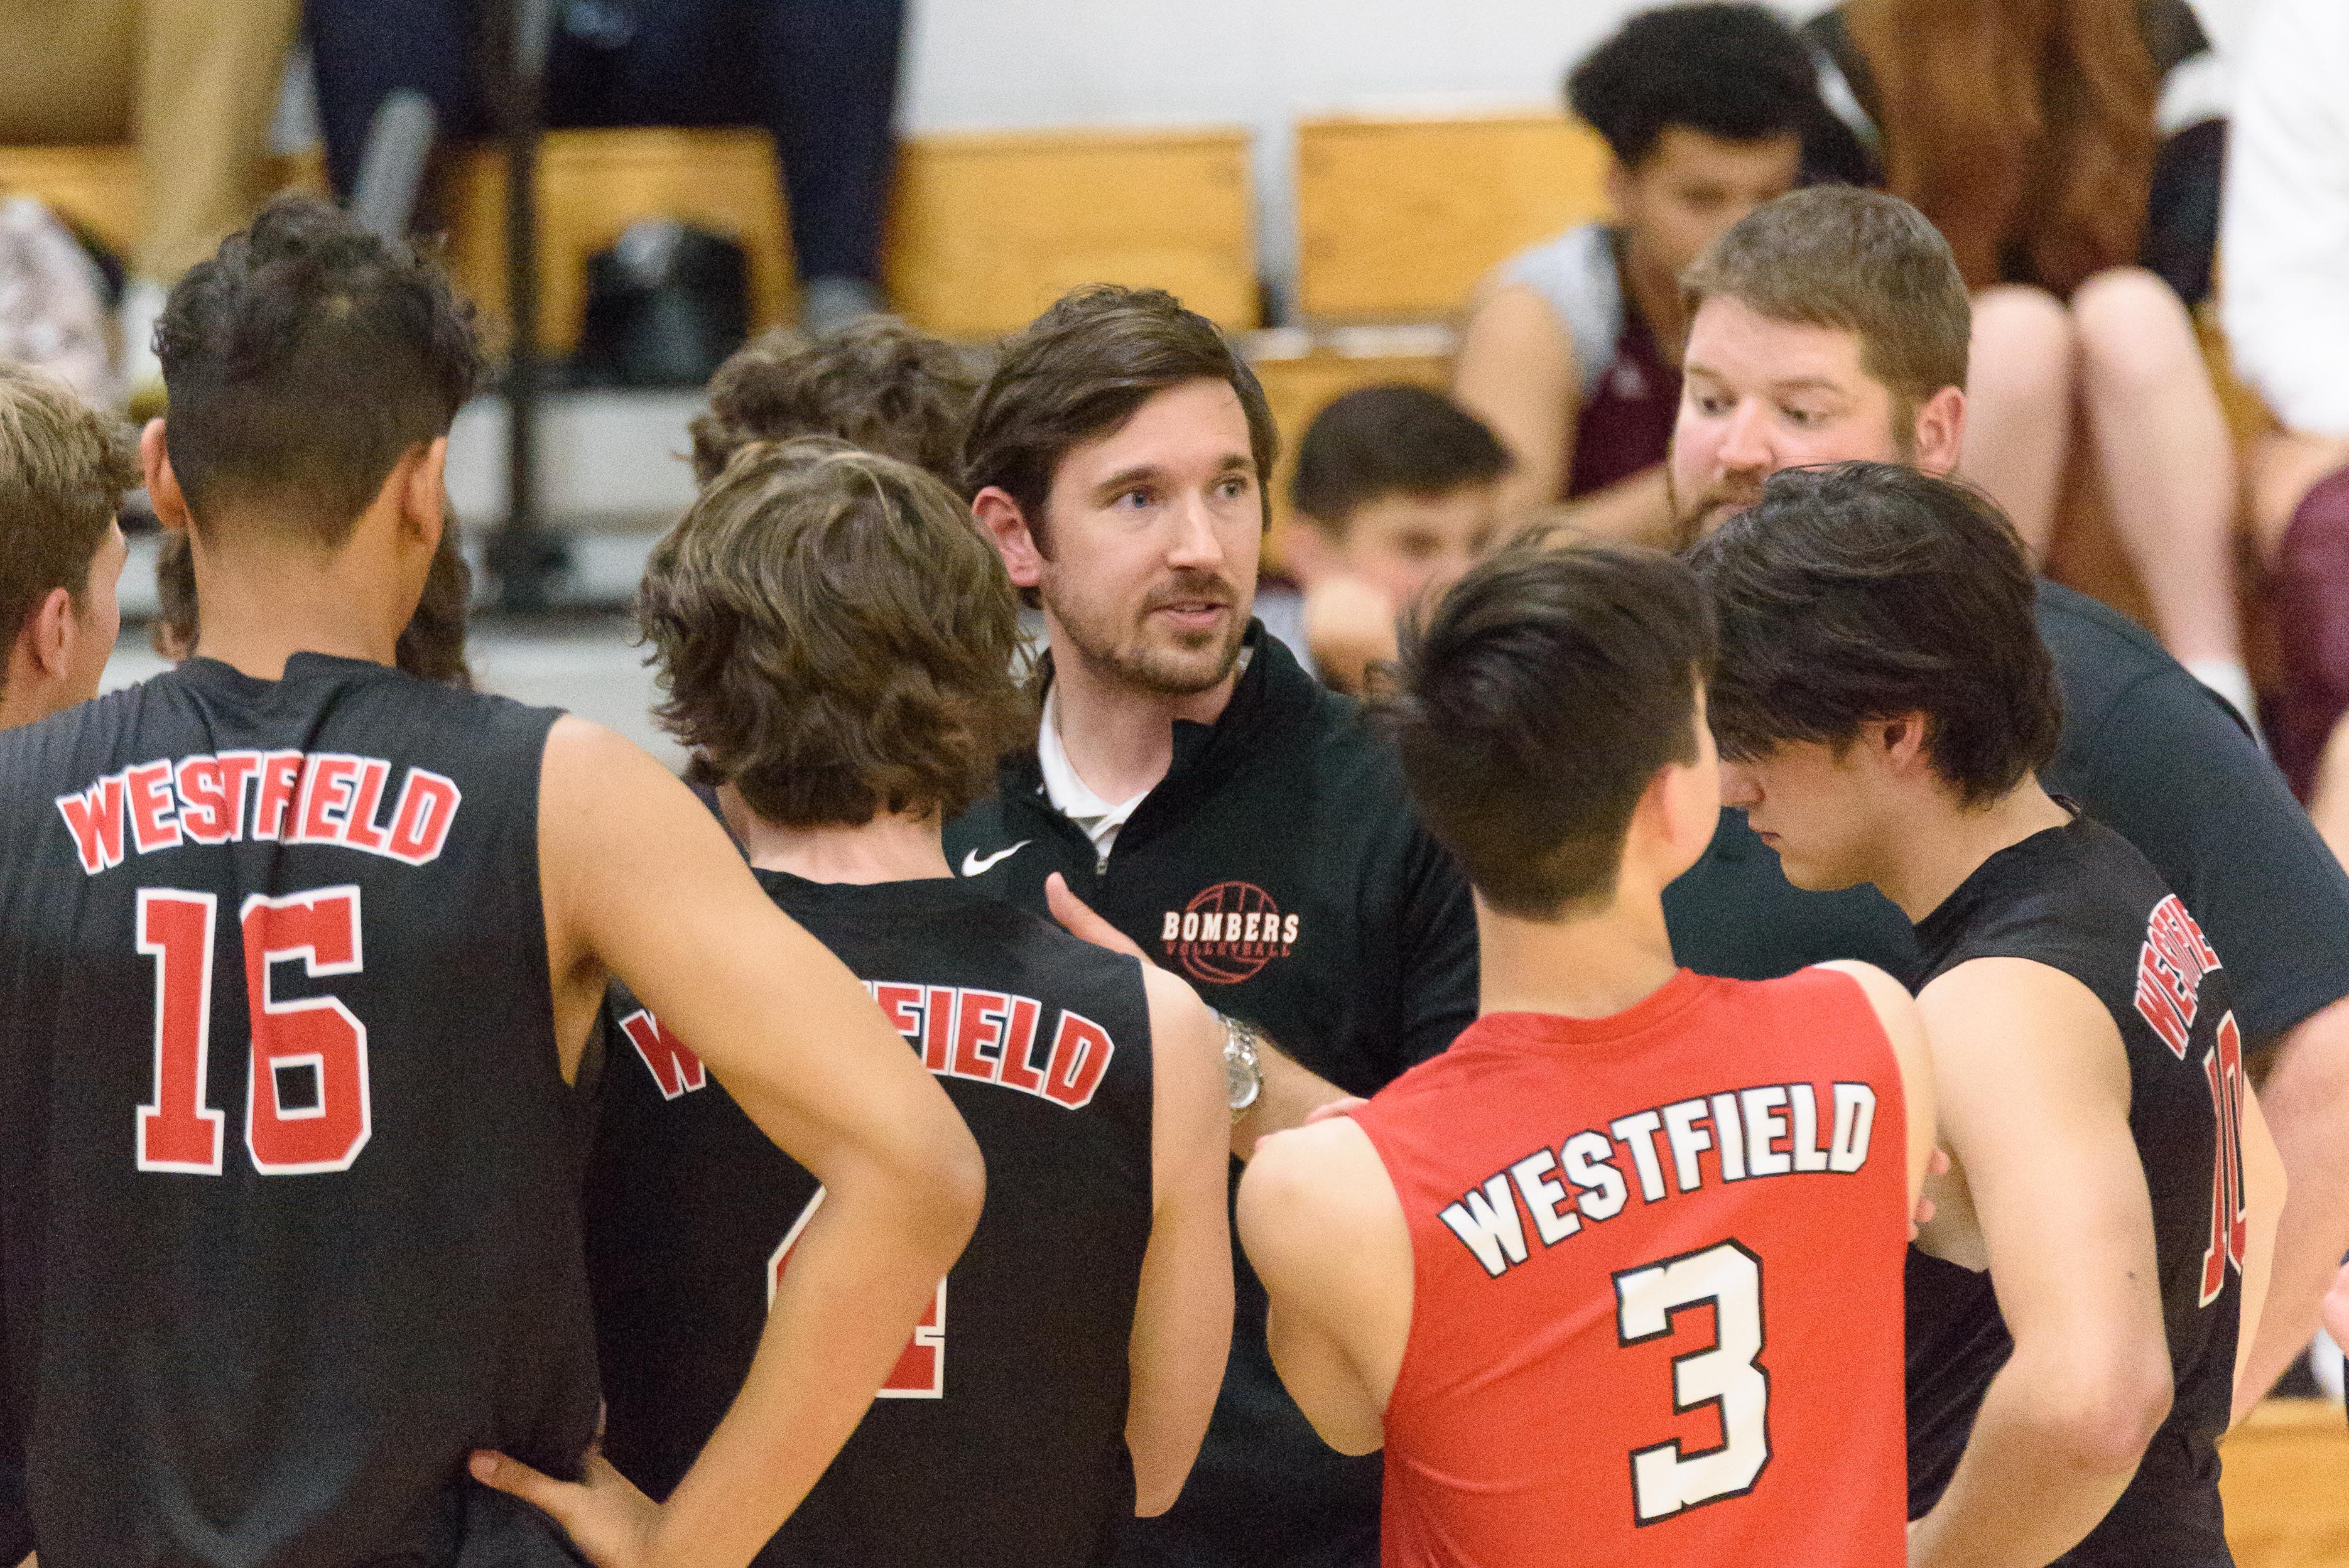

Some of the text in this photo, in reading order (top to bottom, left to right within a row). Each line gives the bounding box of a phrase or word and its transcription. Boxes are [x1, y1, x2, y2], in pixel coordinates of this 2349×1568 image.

[56, 750, 462, 875] WESTFIELD
[1161, 911, 1299, 944] BOMBERS
[136, 885, 372, 1176] 16
[619, 980, 1114, 1110] WFIELD
[1437, 1081, 1877, 1279] WESTFIELD
[1611, 1237, 1772, 1528] 3
